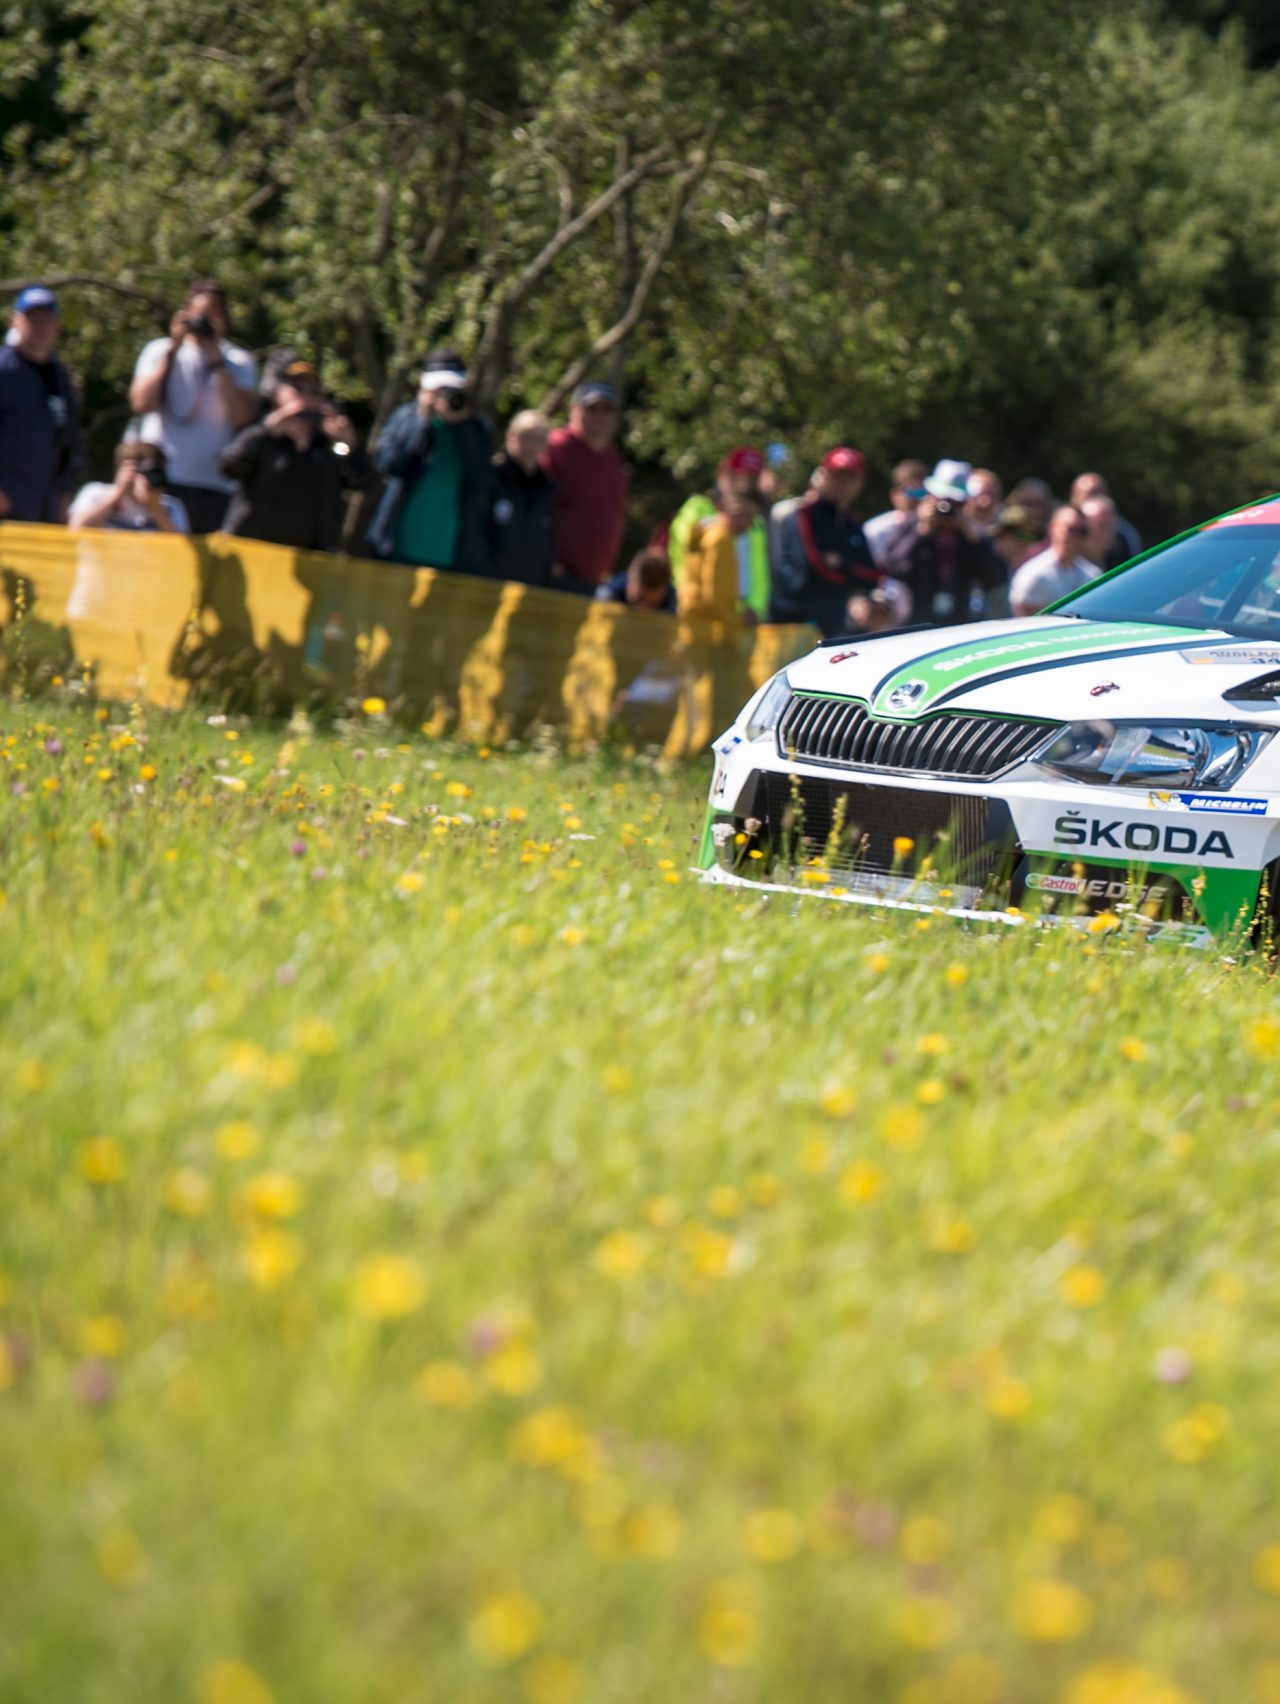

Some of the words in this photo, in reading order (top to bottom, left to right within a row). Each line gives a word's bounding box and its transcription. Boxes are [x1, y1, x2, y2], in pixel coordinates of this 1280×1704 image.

[1189, 798, 1267, 812] MICHELIN
[1053, 810, 1235, 859] ŠKODA
[1041, 876, 1080, 893] Castrol
